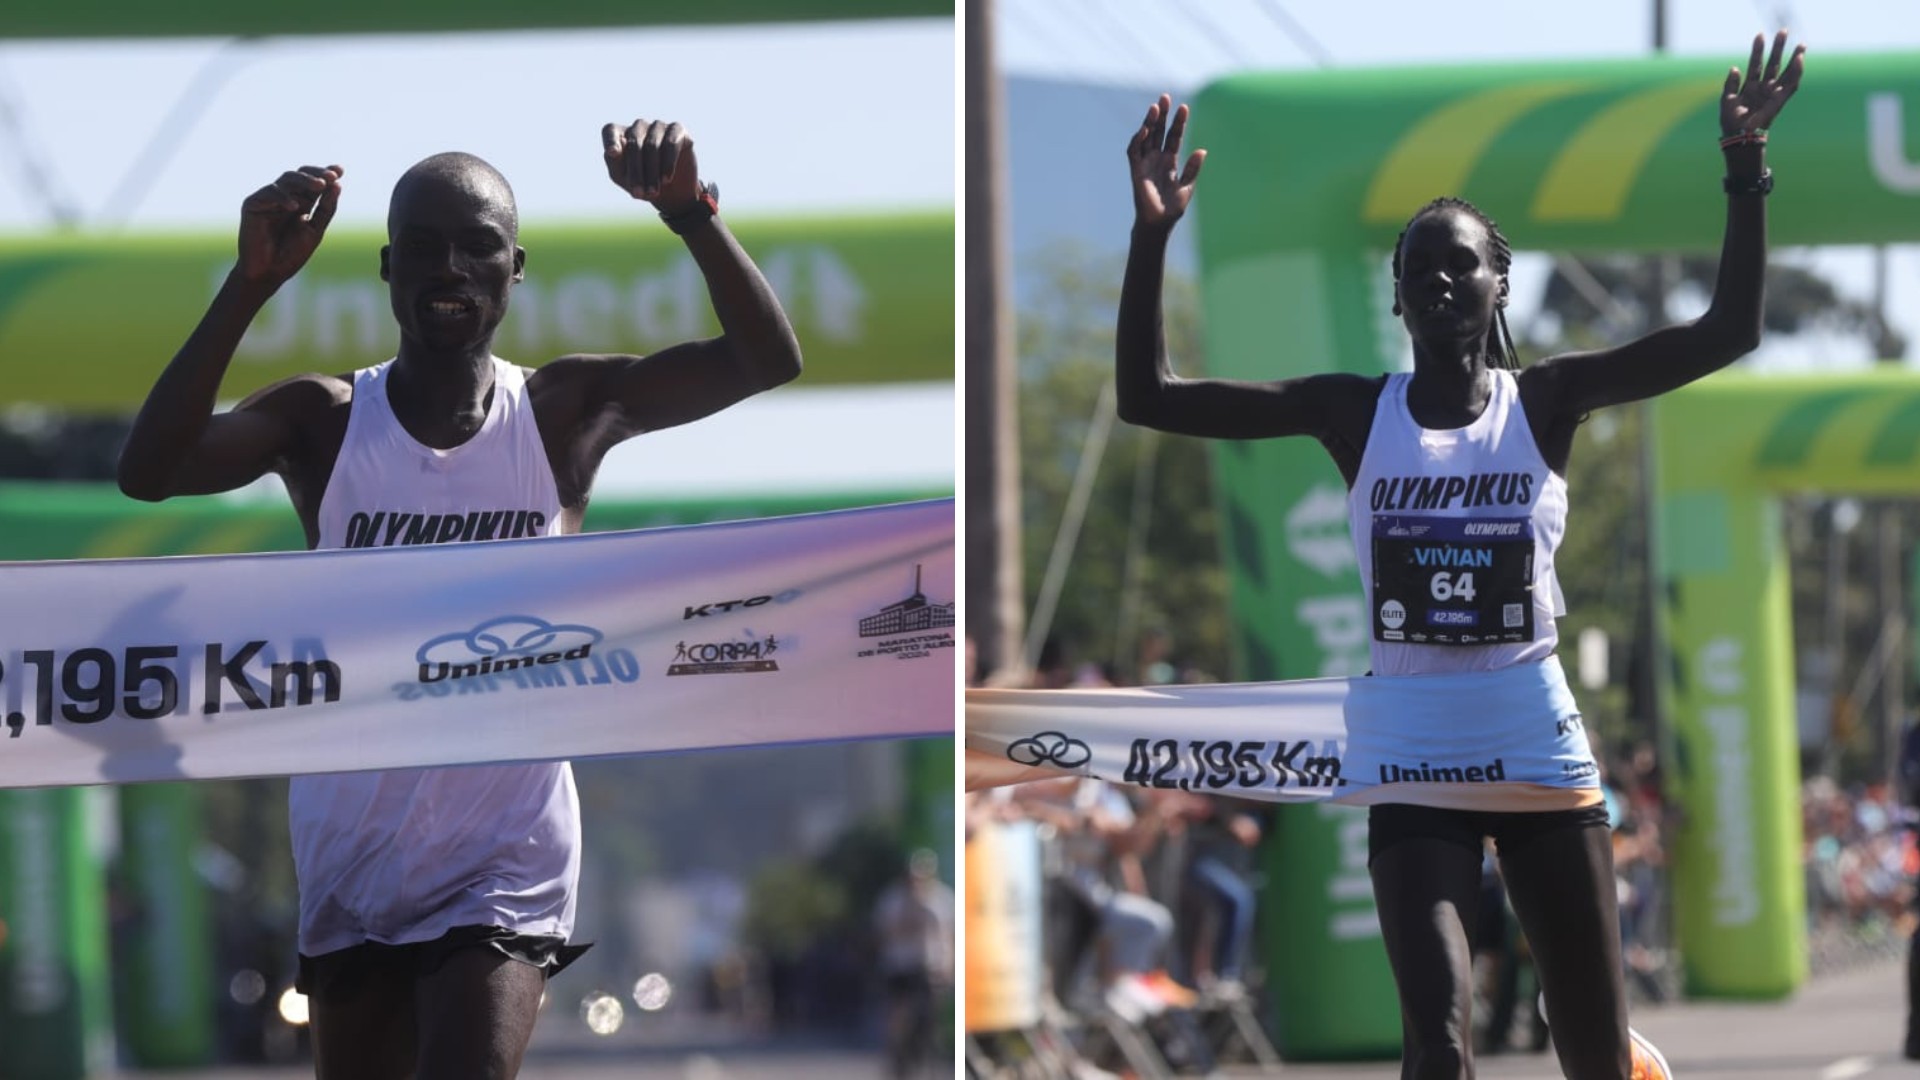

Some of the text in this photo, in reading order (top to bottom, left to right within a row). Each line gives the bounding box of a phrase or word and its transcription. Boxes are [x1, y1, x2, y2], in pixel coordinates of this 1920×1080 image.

[1371, 473, 1534, 512] OLYMPIKUS
[345, 510, 545, 548] OLYMPIKUS
[1464, 522, 1521, 536] OLYMPIKUS
[1414, 547, 1493, 568] VIVIAN
[1430, 571, 1477, 602] 64
[683, 595, 773, 619] KTO
[1382, 609, 1404, 619] ELITE
[878, 632, 951, 647] MARATONA
[418, 643, 592, 683] Unimed
[0, 640, 342, 738] ,195 Km
[1123, 738, 1267, 791] 42,195
[1380, 758, 1506, 784] Unimed
